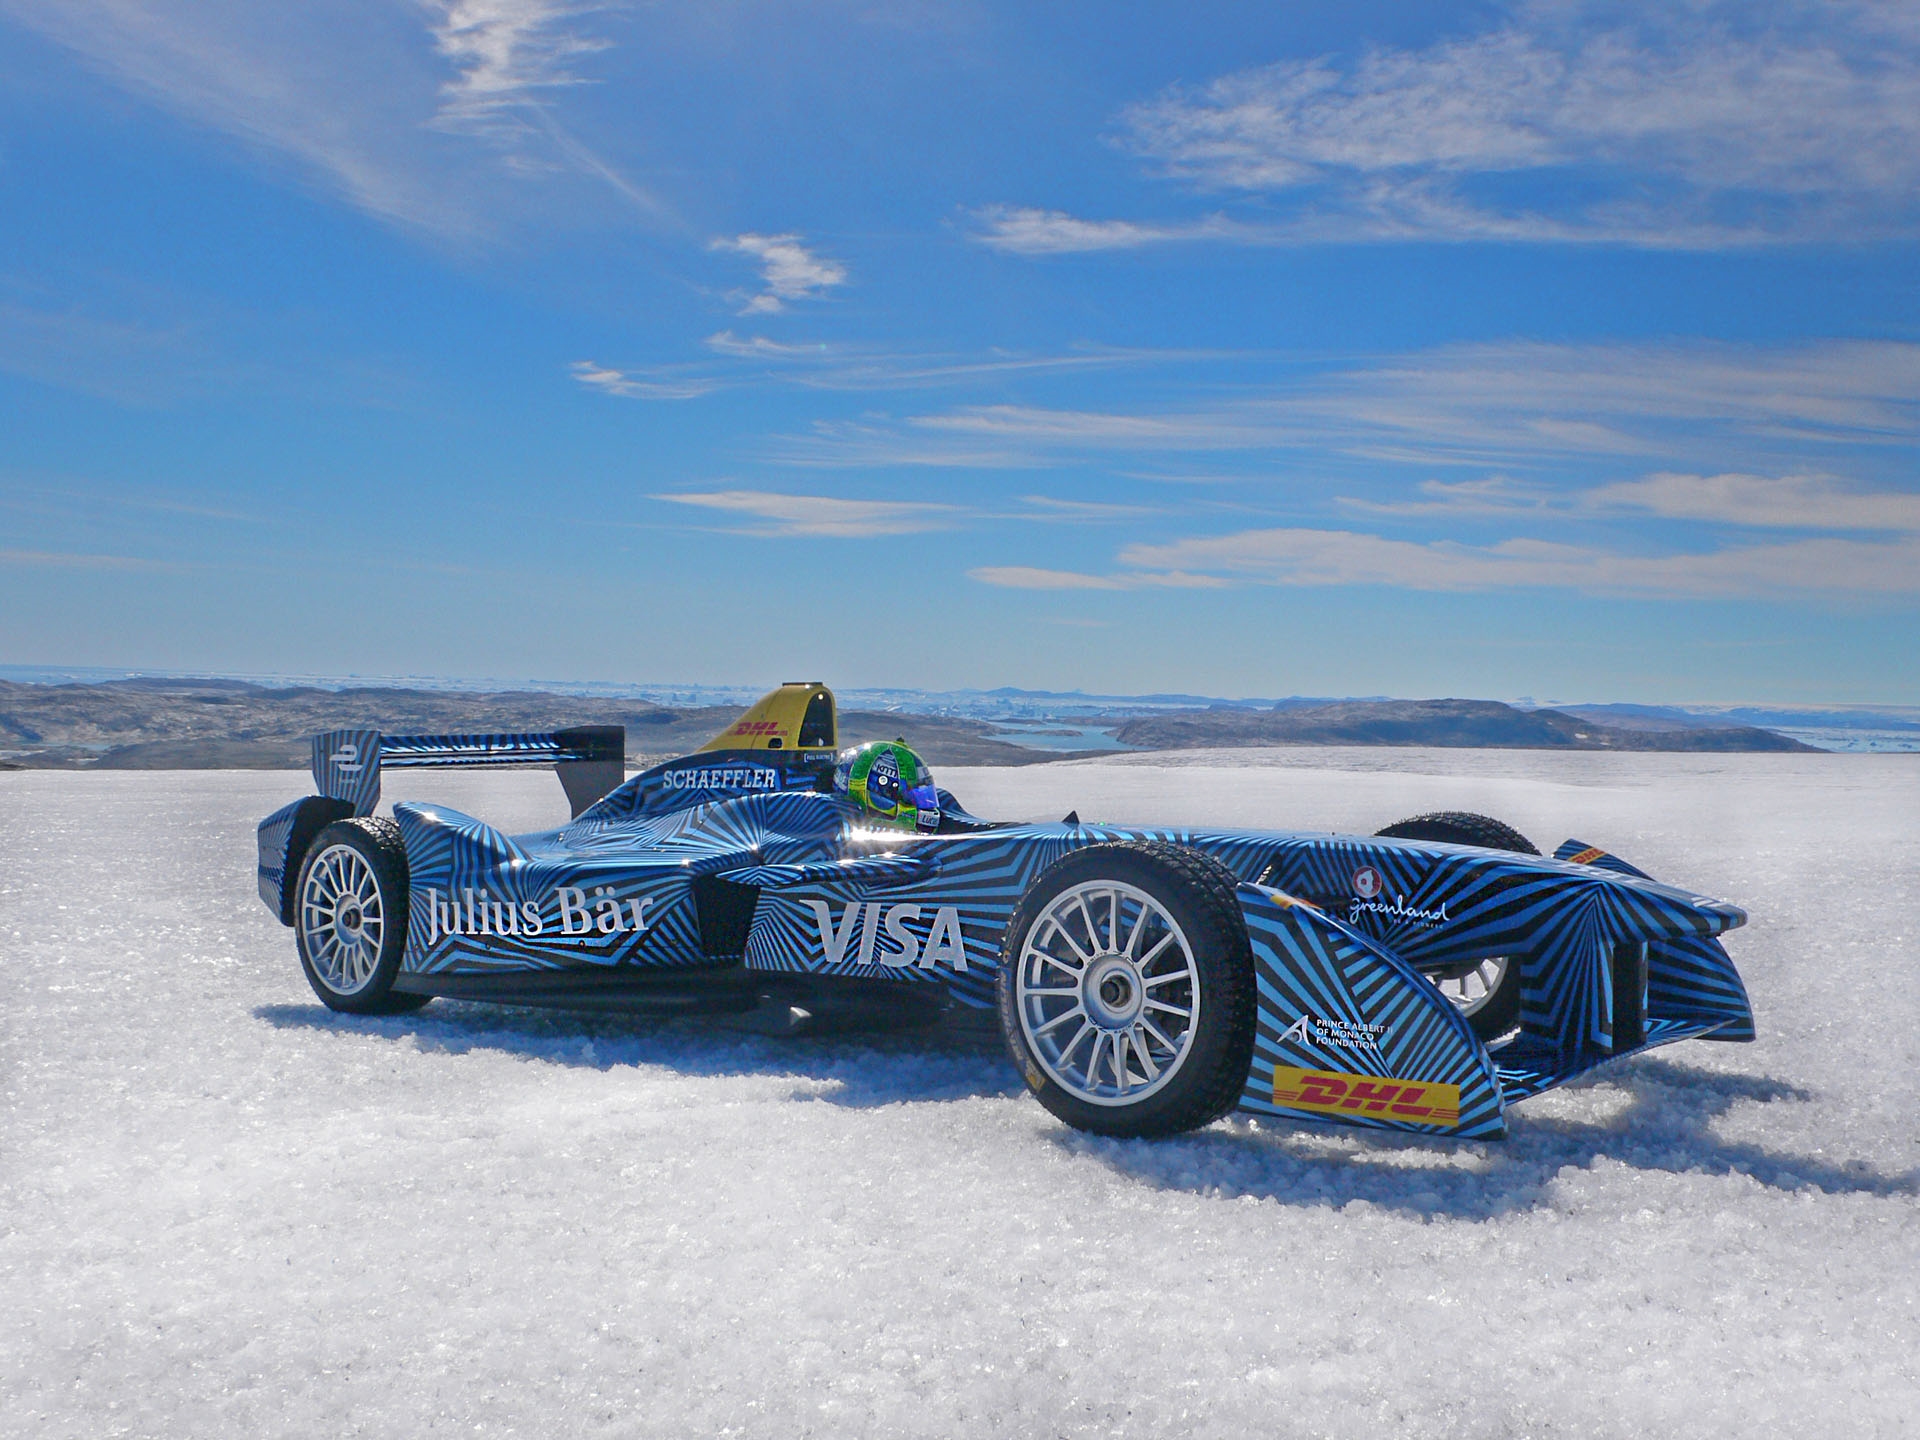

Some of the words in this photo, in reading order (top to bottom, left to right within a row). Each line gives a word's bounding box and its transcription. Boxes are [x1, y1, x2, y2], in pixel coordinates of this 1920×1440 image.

[736, 722, 778, 735] DHL
[663, 769, 776, 789] SCHAEFFLER
[427, 887, 543, 946] Julius
[555, 886, 654, 935] Bär
[799, 899, 969, 972] VISA
[1316, 1019, 1349, 1030] PRINCE
[1352, 1022, 1385, 1034] ALBERT
[1316, 1027, 1329, 1036] OF
[1331, 1029, 1375, 1041] MONACO
[1316, 1036, 1378, 1050] FOUNDATION
[1296, 1075, 1433, 1118] DHL
